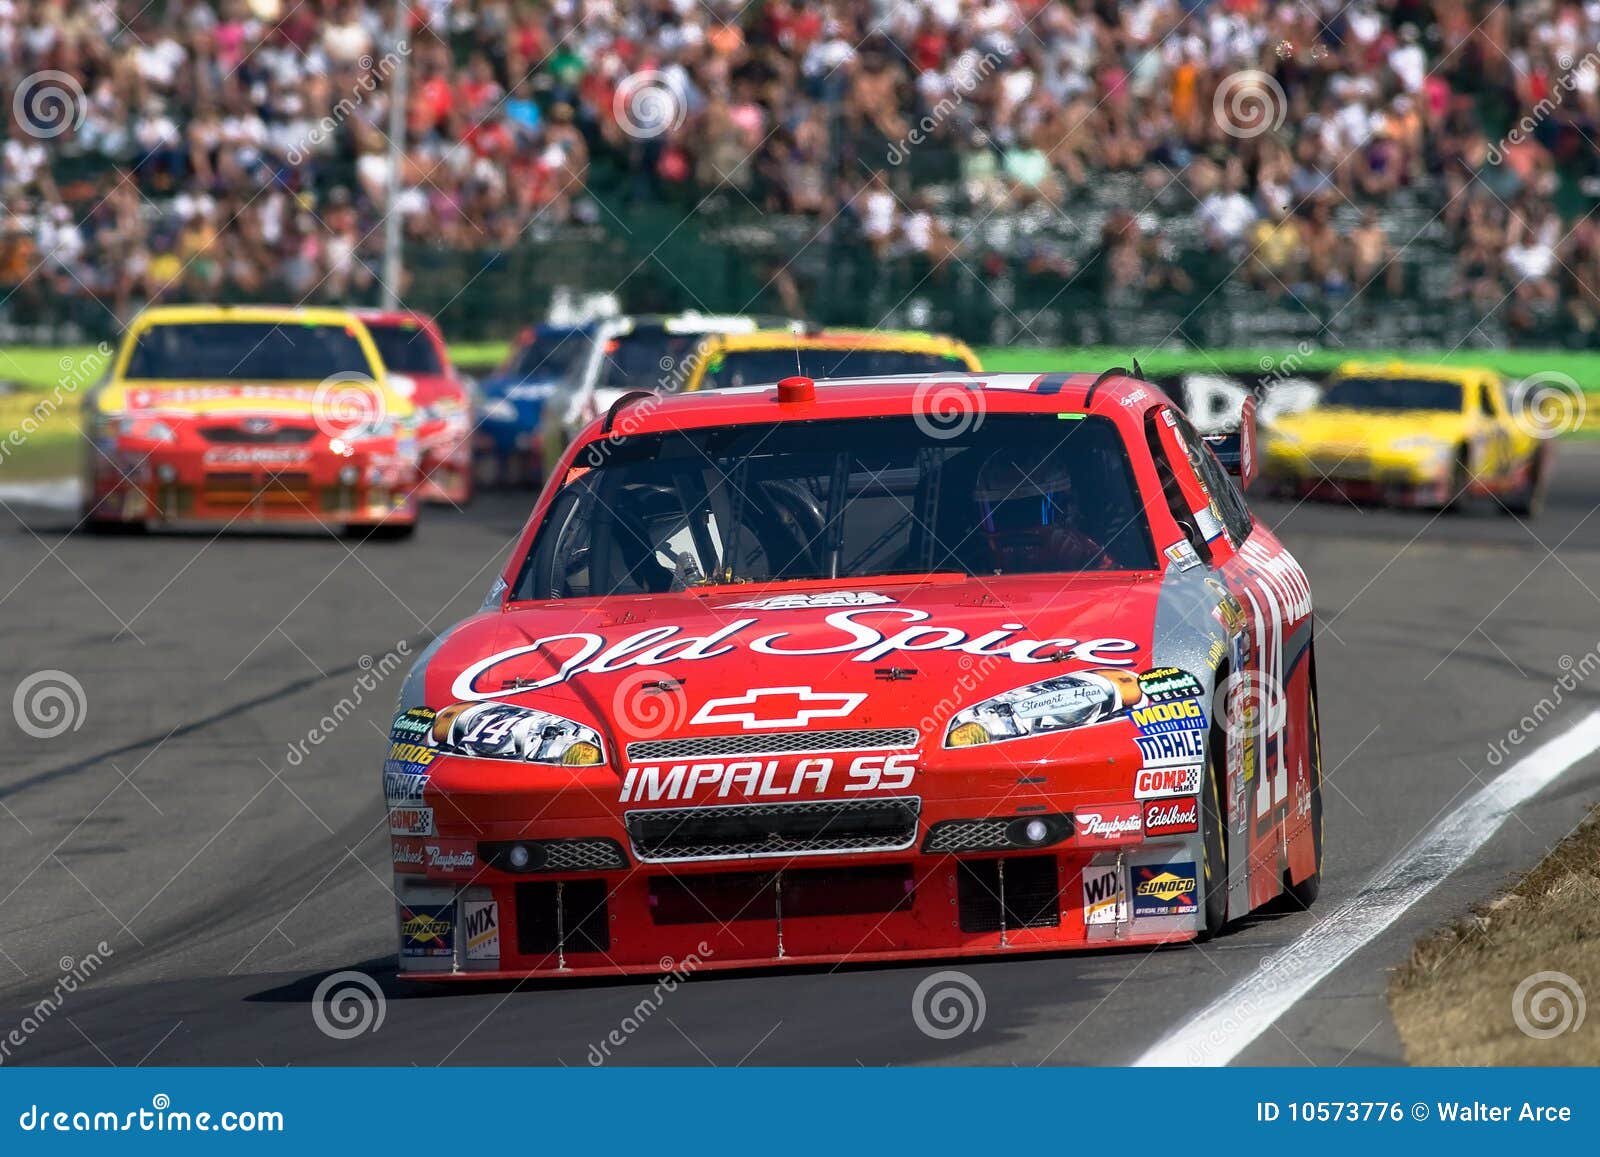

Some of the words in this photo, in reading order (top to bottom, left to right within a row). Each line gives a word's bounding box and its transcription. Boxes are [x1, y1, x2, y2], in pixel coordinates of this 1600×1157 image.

[451, 618, 758, 701] Old
[749, 608, 1137, 664] Spice
[1020, 694, 1064, 714] Stewart
[1074, 687, 1102, 699] Haas
[1152, 687, 1201, 701] BELTS
[1132, 699, 1201, 728] MOOG
[463, 714, 521, 745] 14
[391, 744, 439, 766] MOOG
[1136, 730, 1202, 760] MAHLE
[619, 758, 834, 803] IMPALA
[844, 754, 921, 792] SS
[1139, 769, 1187, 792] COMP
[1173, 784, 1194, 793] CAMS
[1146, 804, 1197, 828] Edelbrock
[1085, 871, 1124, 905] WIX
[1138, 879, 1195, 894] SUNOCO
[400, 921, 448, 935] SUNOCO
[465, 904, 496, 940] WIX
